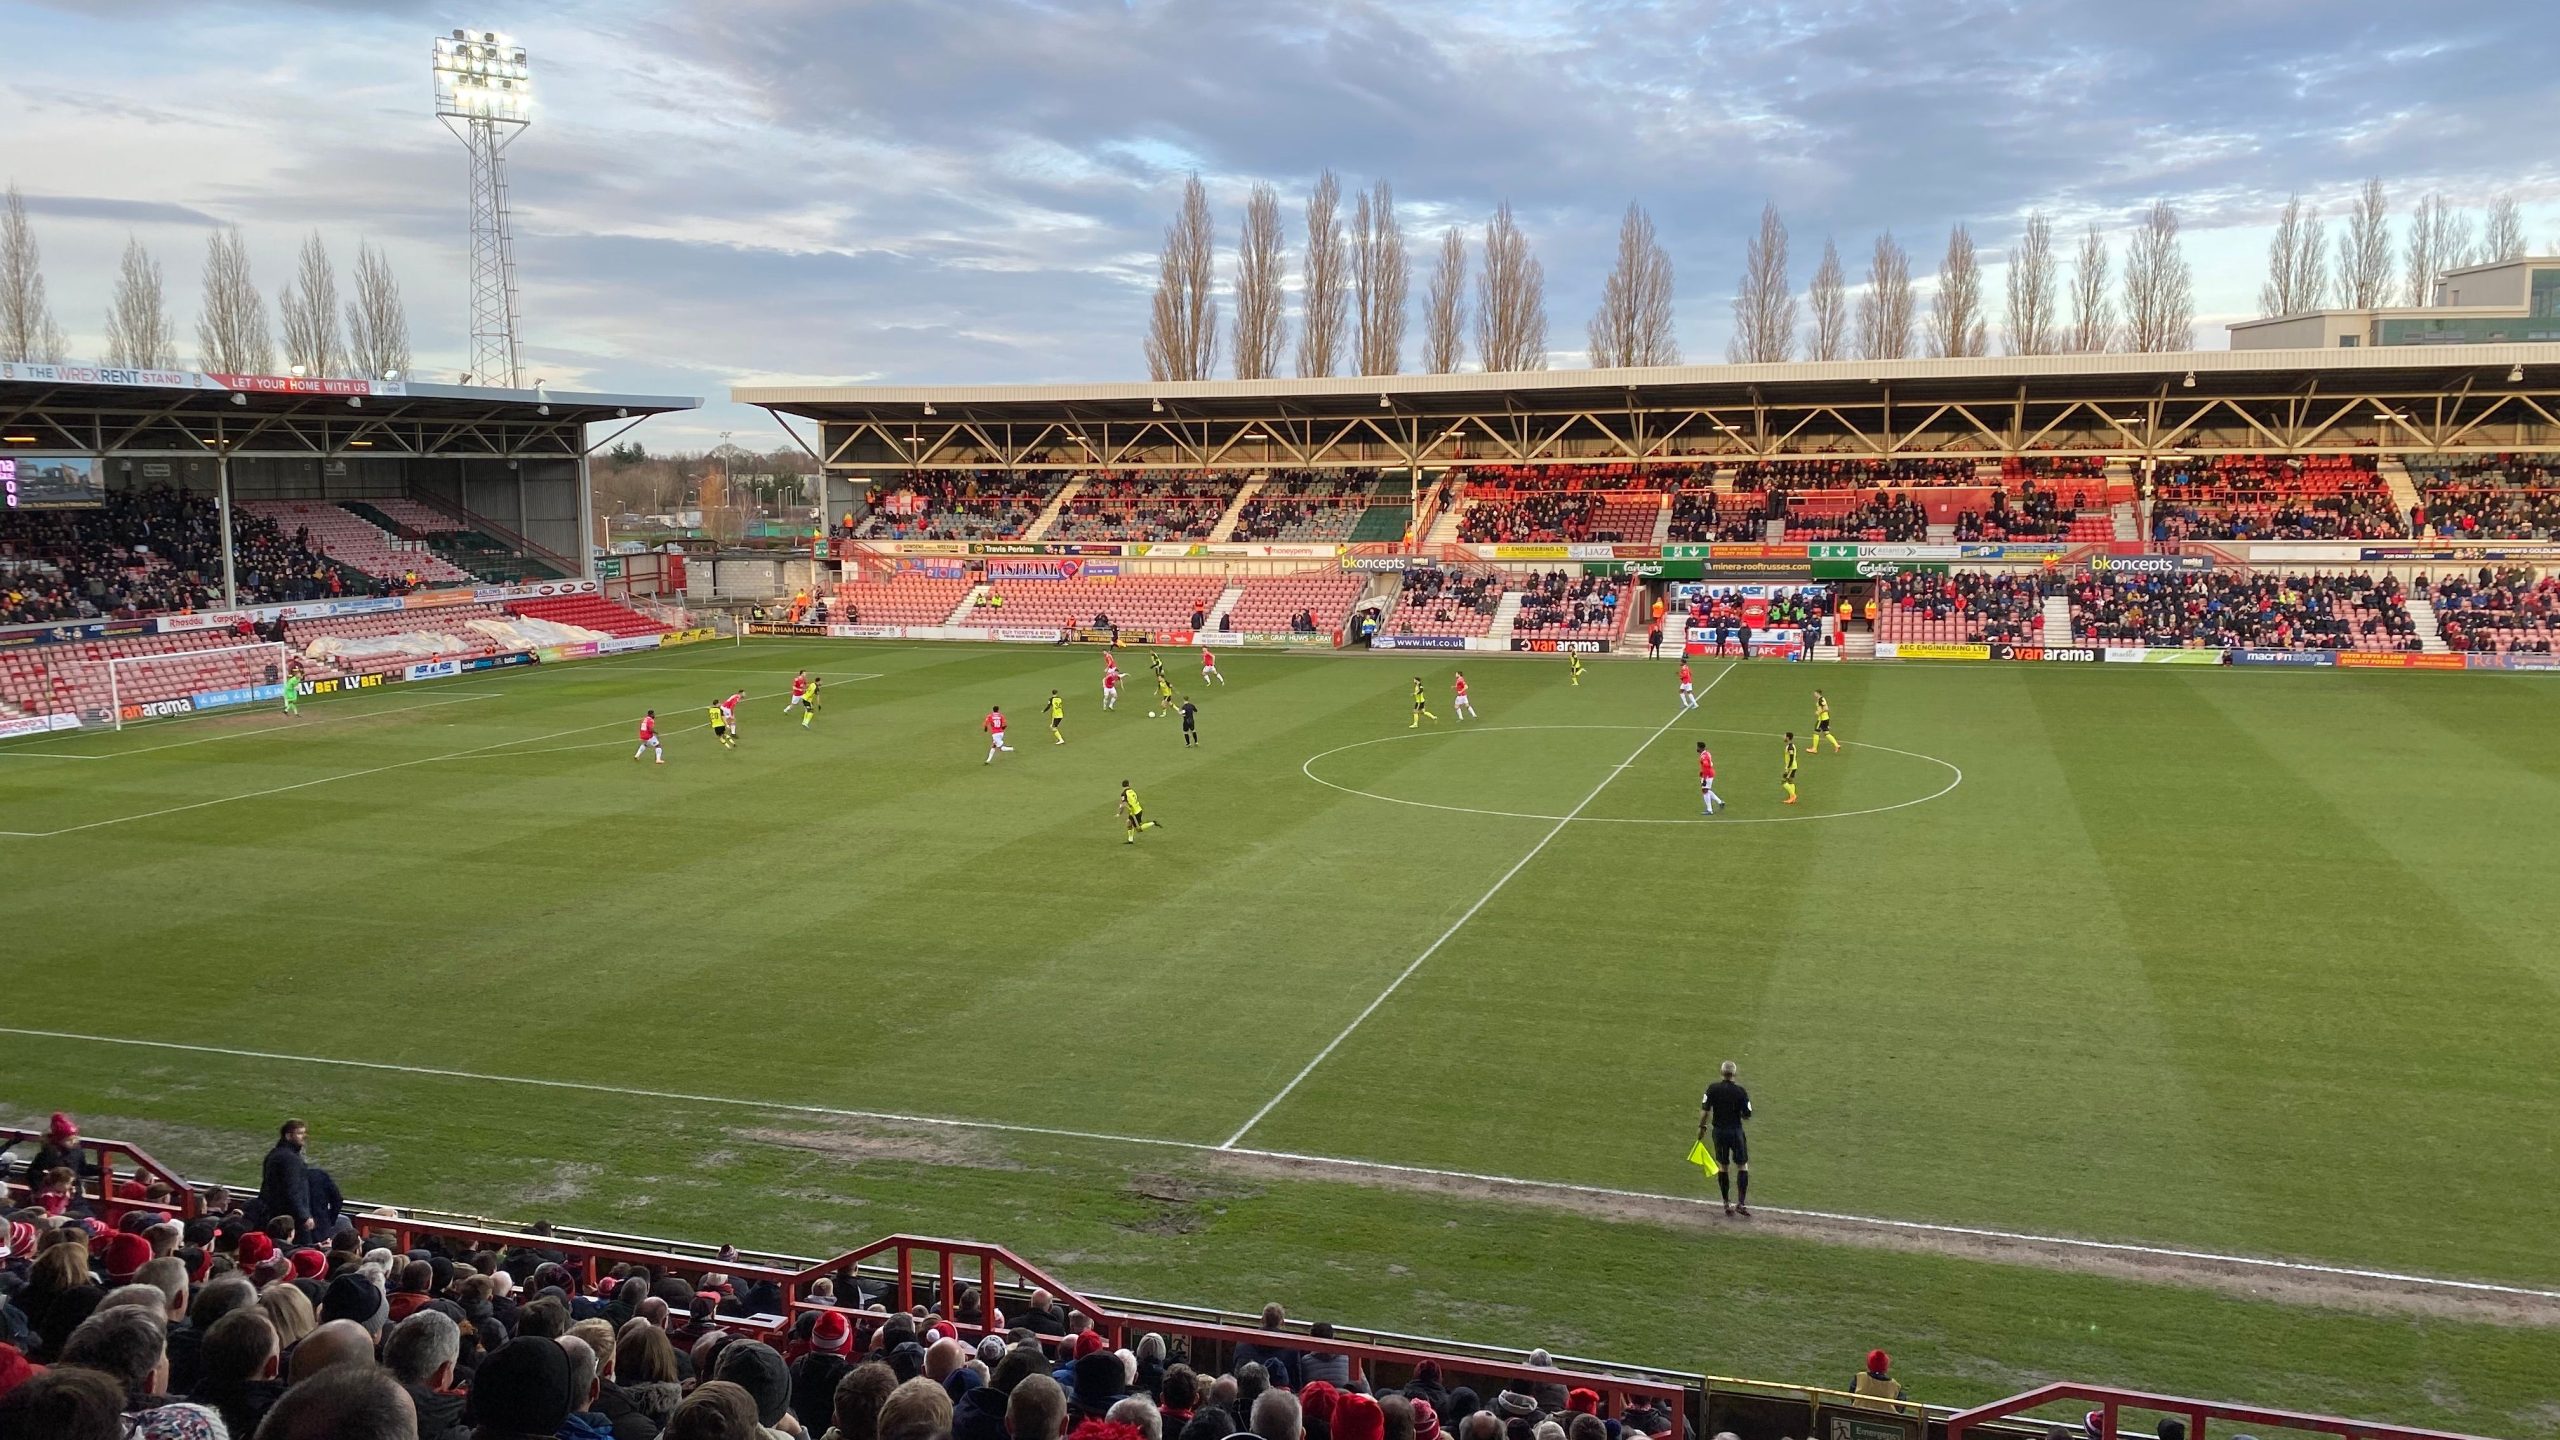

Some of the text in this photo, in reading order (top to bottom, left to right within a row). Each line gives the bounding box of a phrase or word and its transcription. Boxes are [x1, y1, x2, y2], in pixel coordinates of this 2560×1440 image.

[27, 366, 182, 385] THE WREXRENT STAND
[232, 377, 367, 392] LET YOUR HOME WITH US
[6, 481, 16, 493] 0
[7, 495, 17, 507] 0
[985, 545, 1034, 553] Travis Perkins
[1587, 547, 1610, 556] JAZZ
[1859, 547, 1877, 556] UK
[1341, 556, 1405, 571] bkoncepts
[1623, 560, 1664, 575] Carlsberg
[1712, 562, 1811, 571] minera-rooftrusses.com
[2092, 556, 2172, 572] bkoncepts
[1740, 586, 1764, 595] AST
[756, 625, 819, 634] WREXHAM LAGER
[1396, 637, 1464, 648] www.iwt.co.uk
[1532, 639, 1600, 652] vanarama
[1758, 646, 1777, 655] AFC
[2016, 647, 2094, 662] vanarama
[119, 699, 191, 720] anarama
